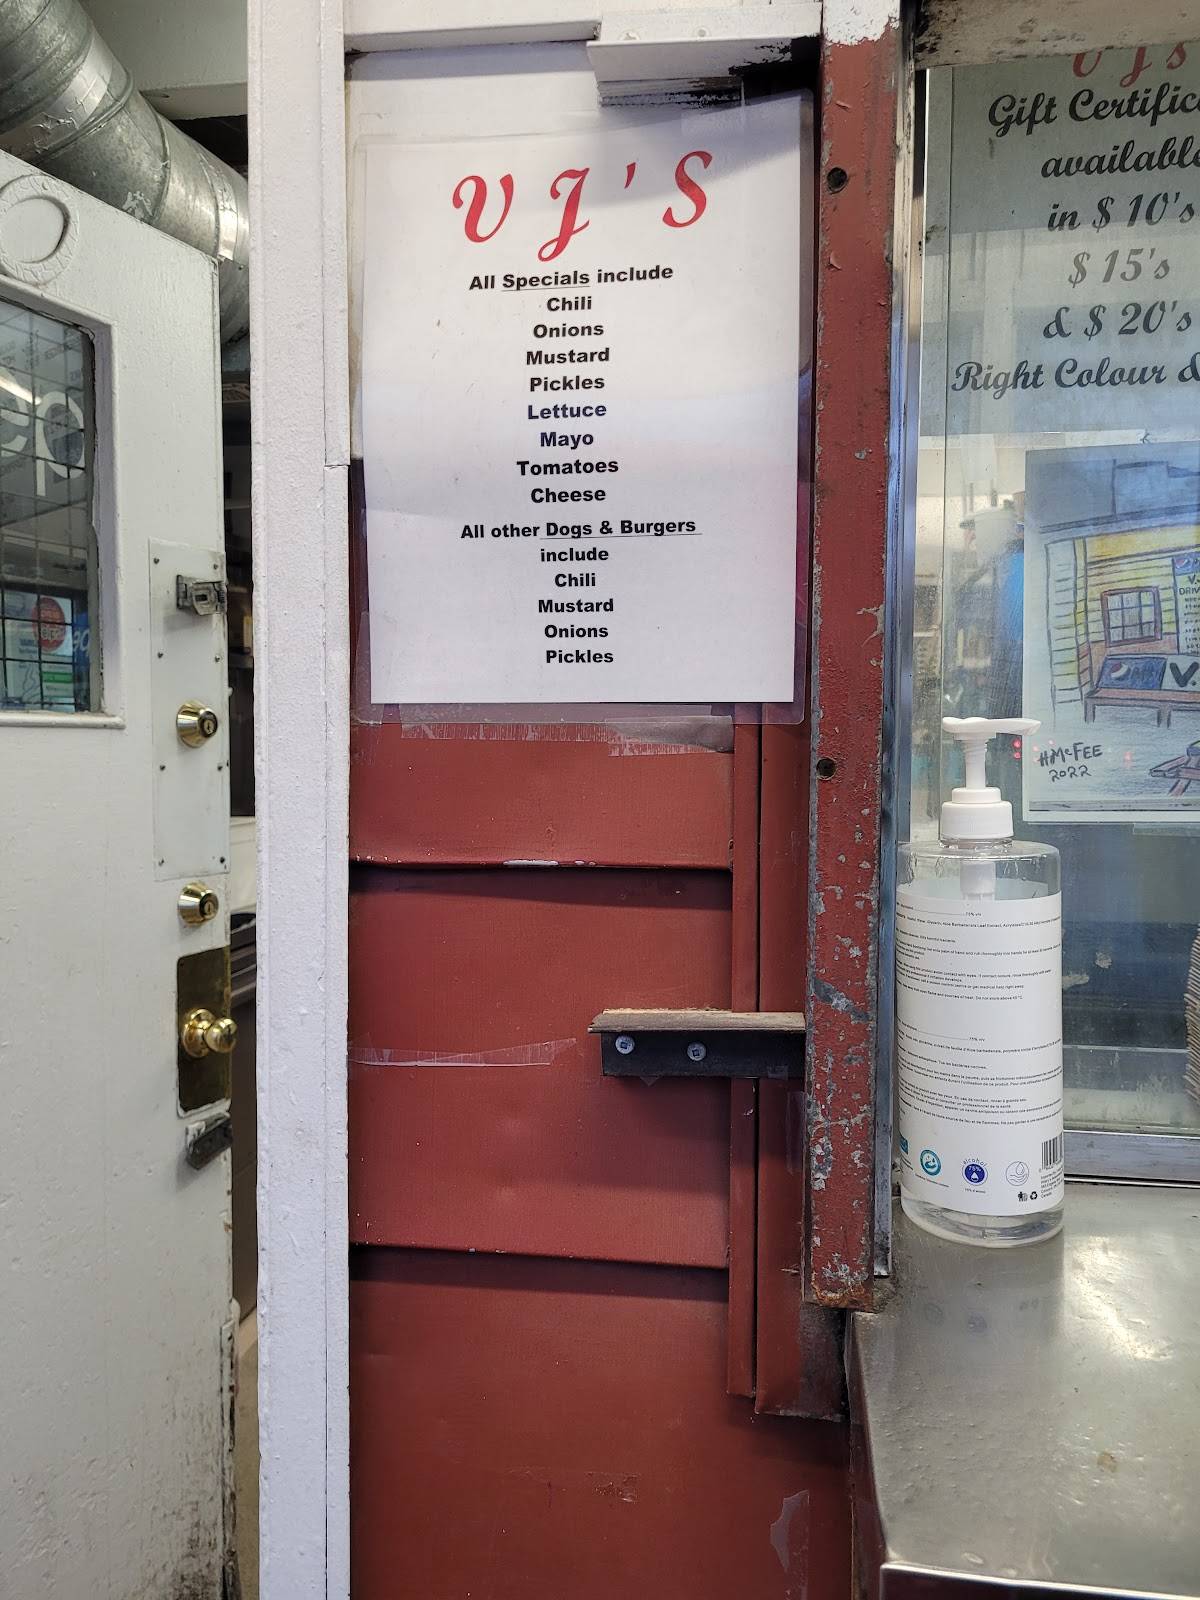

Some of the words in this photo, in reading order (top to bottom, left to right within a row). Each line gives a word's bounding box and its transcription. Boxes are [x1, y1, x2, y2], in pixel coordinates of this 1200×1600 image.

[989, 93, 1057, 137] Gift
[1069, 83, 1200, 127] Certific
[1048, 203, 1081, 231] in
[1092, 196, 1115, 232] $
[1127, 192, 1194, 227] 10's
[1068, 252, 1090, 288] $
[1103, 248, 1170, 283] 15's
[469, 275, 495, 291] All
[502, 270, 590, 290] Specials
[597, 264, 674, 284] include
[546, 296, 592, 312] Chili
[1043, 307, 1072, 338] &
[1084, 304, 1106, 341] $
[1118, 300, 1191, 335] 20's
[533, 324, 604, 339] Onions
[526, 347, 610, 366] Mustard
[530, 375, 605, 393] Pickles
[951, 361, 1044, 400] Right
[1055, 357, 1167, 388] Colour
[527, 403, 607, 420] Lettuce
[540, 431, 594, 451] Mayo
[516, 458, 619, 476] Tomatoes
[530, 487, 606, 504] Cheese
[460, 524, 485, 539] All
[490, 523, 541, 538] other
[547, 522, 593, 538] Dogs
[599, 520, 614, 535] &
[619, 519, 697, 537] Burgers
[540, 546, 609, 563] include
[554, 572, 596, 588] Chili
[538, 598, 614, 613] Mustard
[544, 624, 609, 639] Onions
[545, 649, 614, 664] Pickles
[1048, 765, 1092, 782] 2022
